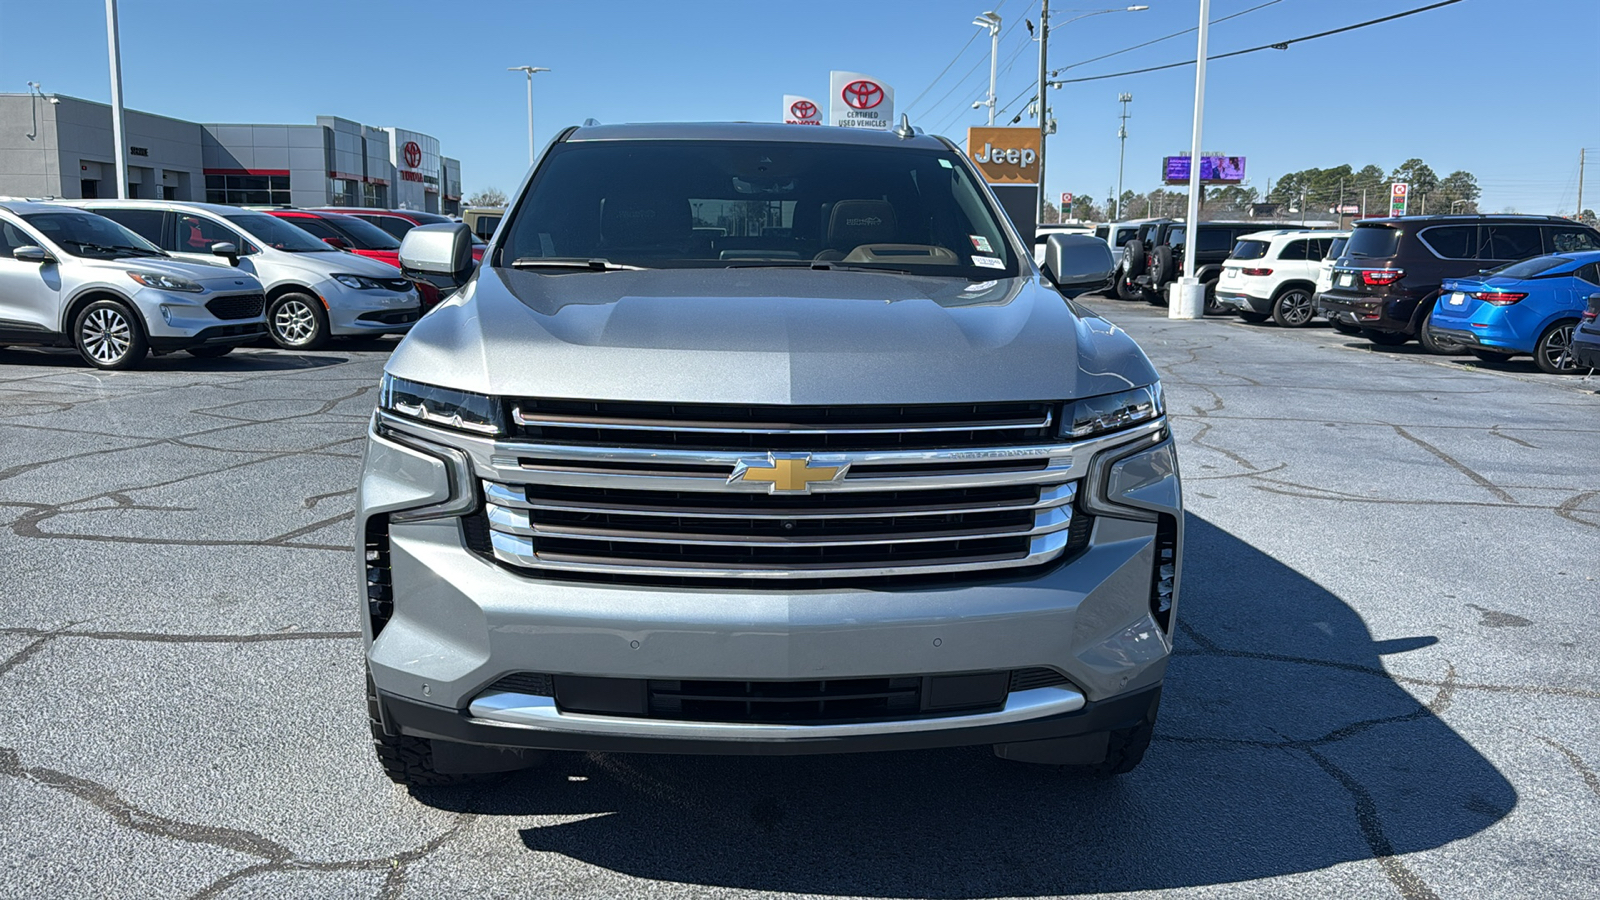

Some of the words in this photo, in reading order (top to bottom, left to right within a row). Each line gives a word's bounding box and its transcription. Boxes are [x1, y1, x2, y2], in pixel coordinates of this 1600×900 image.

[838, 119, 855, 127] USED
[856, 119, 887, 128] VEHICLES
[974, 142, 1036, 168] Jeep
